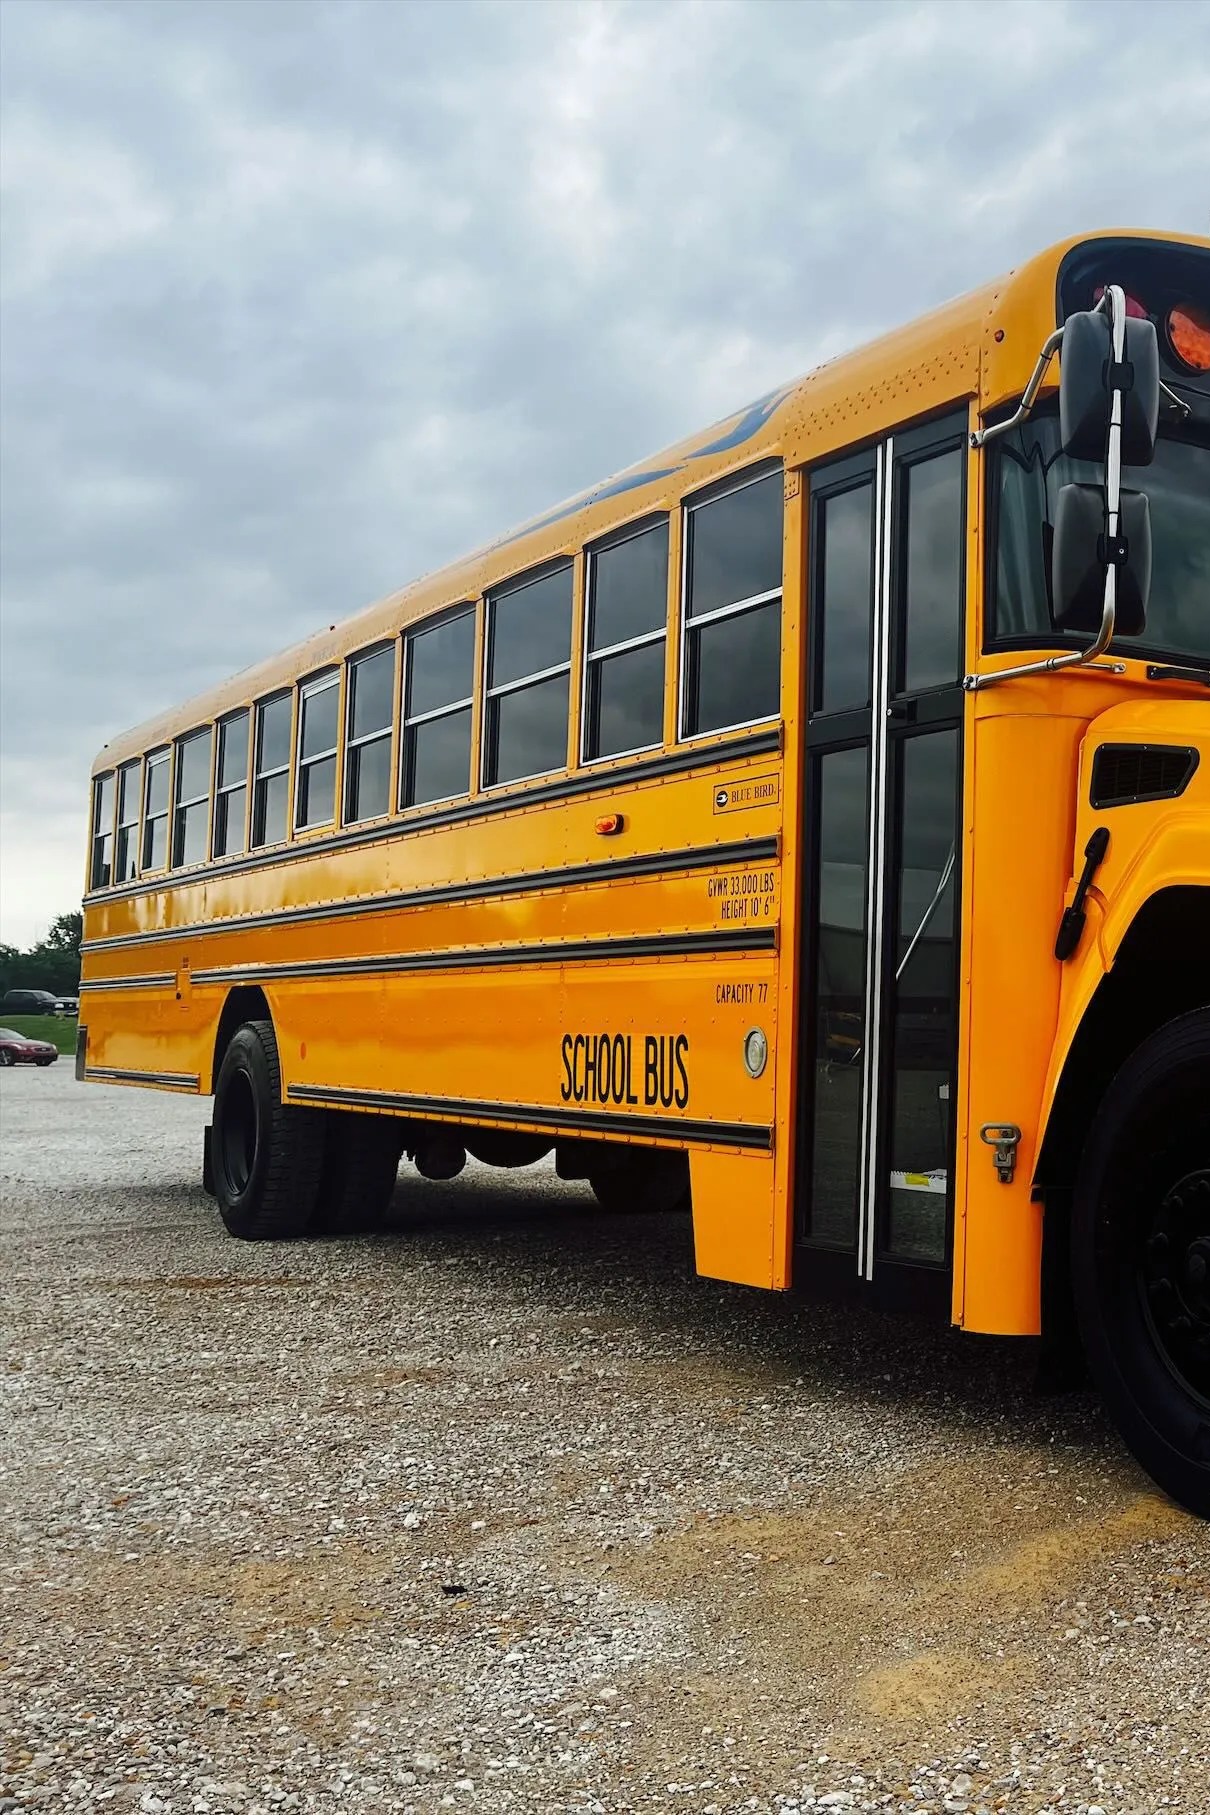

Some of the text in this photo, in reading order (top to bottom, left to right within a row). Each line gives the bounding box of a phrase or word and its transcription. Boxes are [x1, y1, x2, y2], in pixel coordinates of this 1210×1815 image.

[731, 788, 751, 802] BLUE
[708, 877, 728, 897] GVWR
[759, 872, 775, 893] LBS
[721, 898, 748, 920] HEIGHT
[716, 983, 768, 1004] CAPACITY 77
[560, 1033, 689, 1109] SCHOOL BUS
